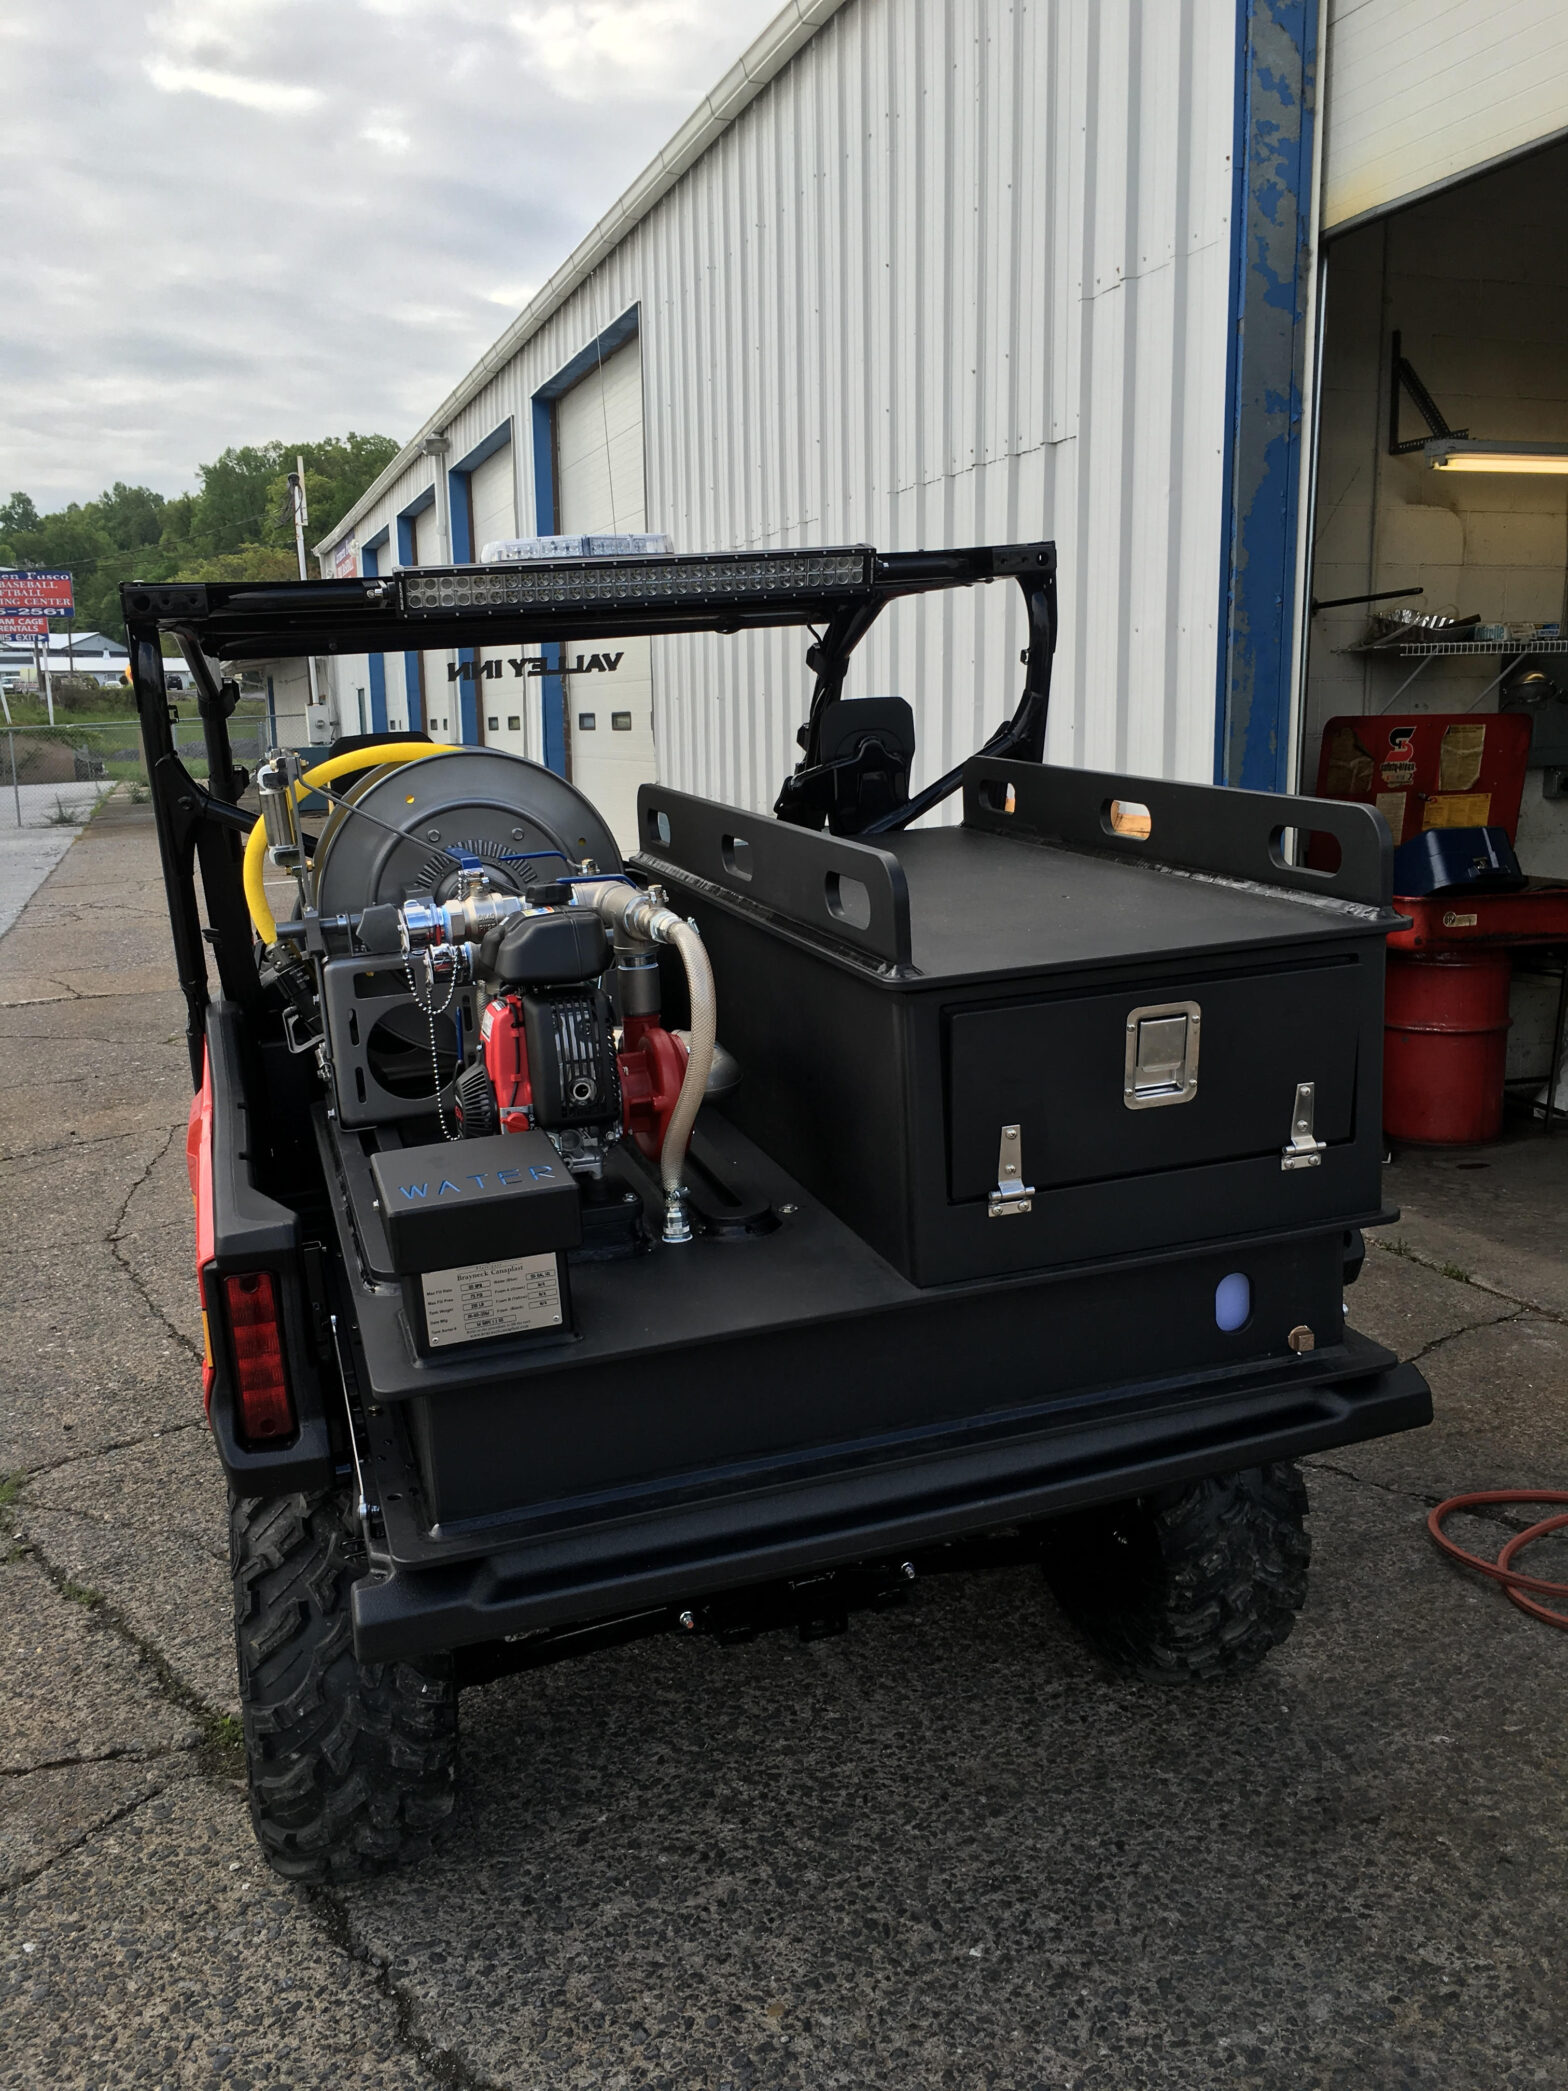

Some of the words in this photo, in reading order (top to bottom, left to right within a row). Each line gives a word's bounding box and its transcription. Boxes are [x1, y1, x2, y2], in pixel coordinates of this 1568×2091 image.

[26, 572, 70, 580] Fusco
[0, 581, 58, 589] BASEBALL
[399, 1165, 555, 1200] WATER
